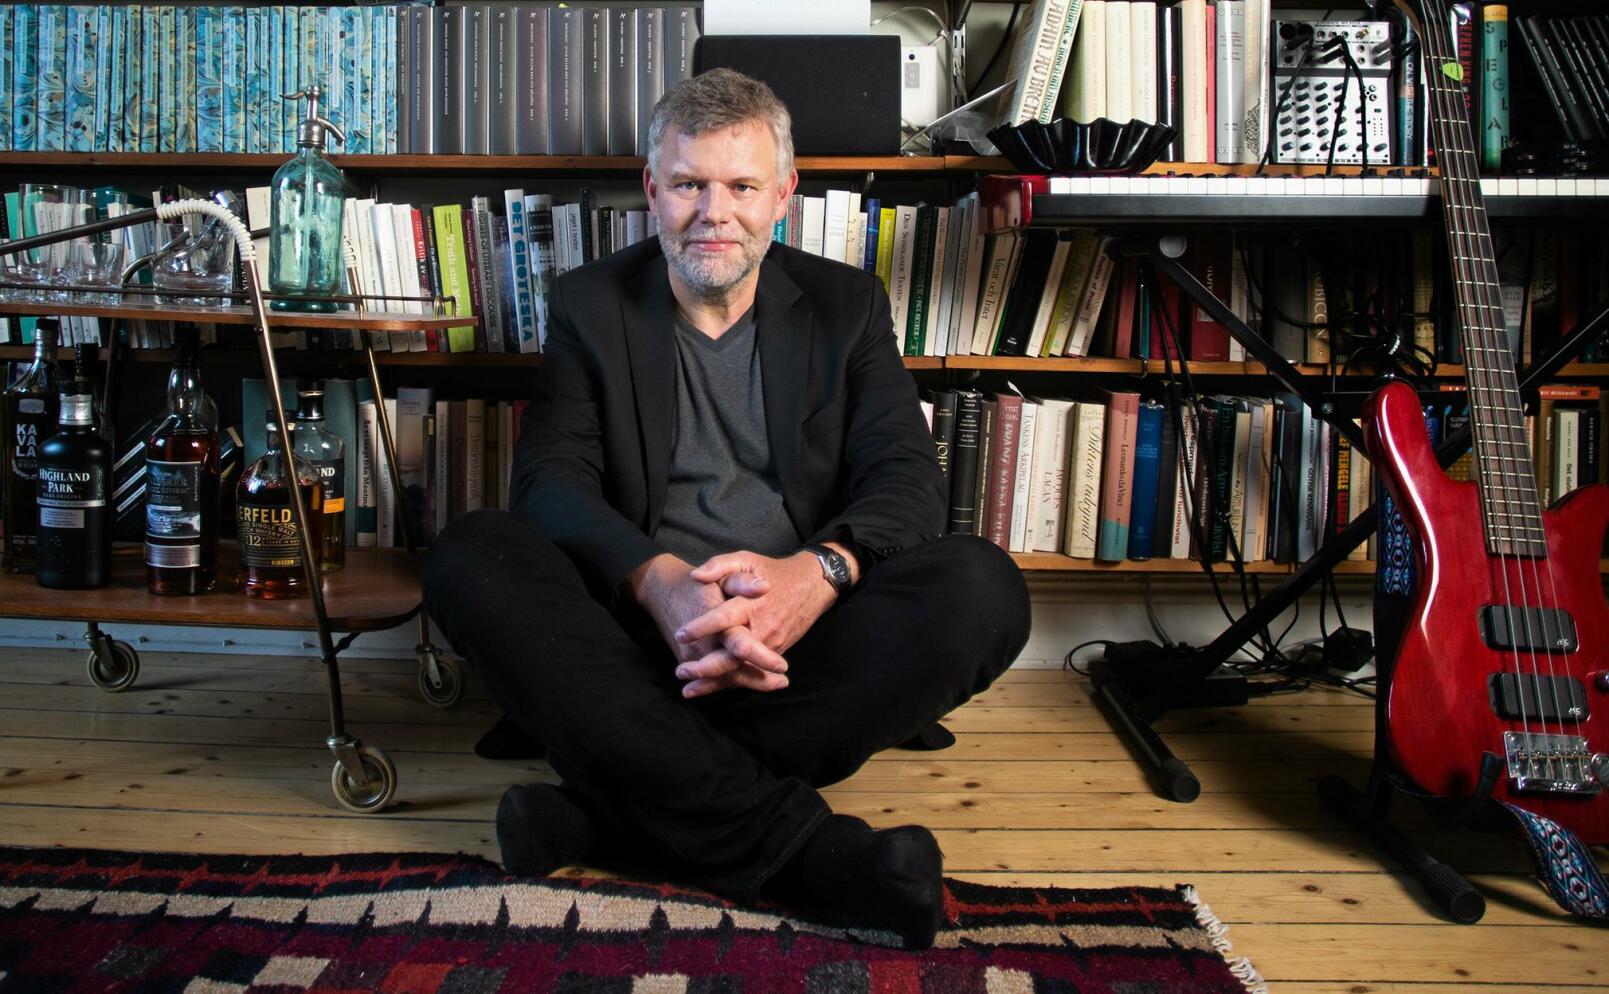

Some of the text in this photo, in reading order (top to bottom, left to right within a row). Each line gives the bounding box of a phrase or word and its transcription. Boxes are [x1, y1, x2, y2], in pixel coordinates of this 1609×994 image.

[902, 213, 912, 229] DEN
[477, 210, 497, 328] FIGURES OF LITERARY DISCOURSE
[511, 201, 533, 342] DET GROTESKA
[981, 257, 1007, 320] Varat och Intet
[16, 423, 38, 435] KA
[16, 435, 38, 446] VA
[1016, 414, 1034, 494] TANKENS ARKIPELAG
[1117, 444, 1129, 479] Leonardo
[1337, 450, 1350, 491] MENGELE
[39, 468, 91, 482] HIGHLAND
[48, 482, 74, 493] PARK
[1041, 471, 1052, 504] LACAN
[1052, 467, 1065, 509] JACQUES
[1078, 425, 1103, 543] Diktens tidrymd
[1174, 501, 1184, 545] lundkvist
